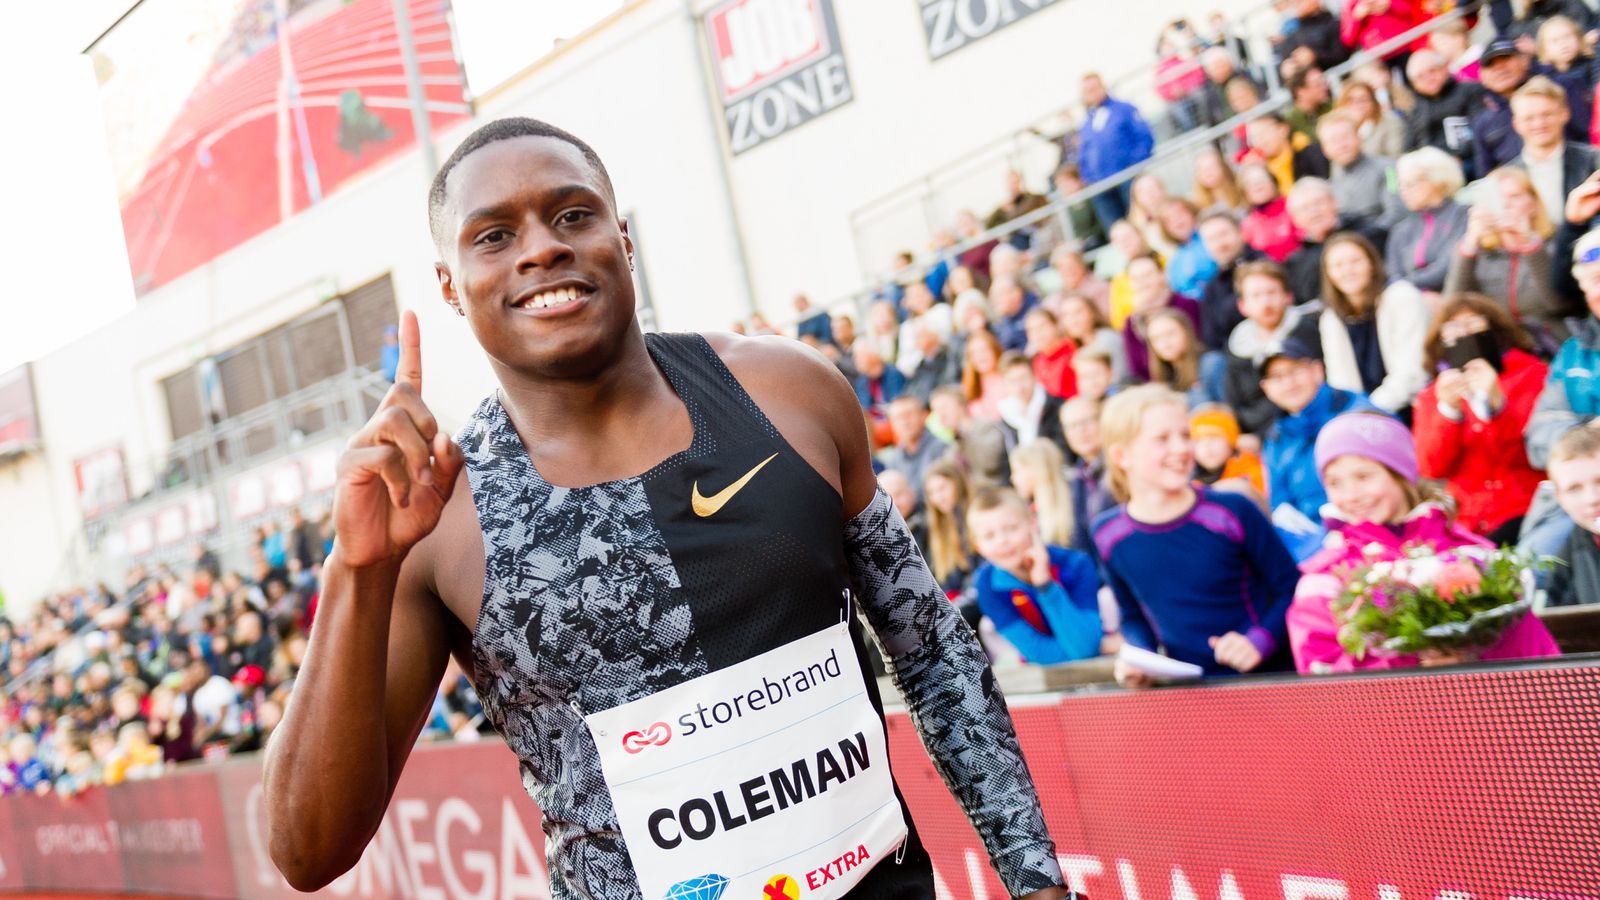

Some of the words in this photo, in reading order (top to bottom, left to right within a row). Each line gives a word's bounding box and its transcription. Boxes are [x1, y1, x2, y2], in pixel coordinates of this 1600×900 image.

[923, 0, 1042, 55] ZO
[726, 54, 851, 152] ZONE
[678, 648, 841, 736] storebrand
[647, 731, 871, 850] COLEMAN
[326, 794, 549, 900] MEGA
[806, 844, 870, 891] EXTRA
